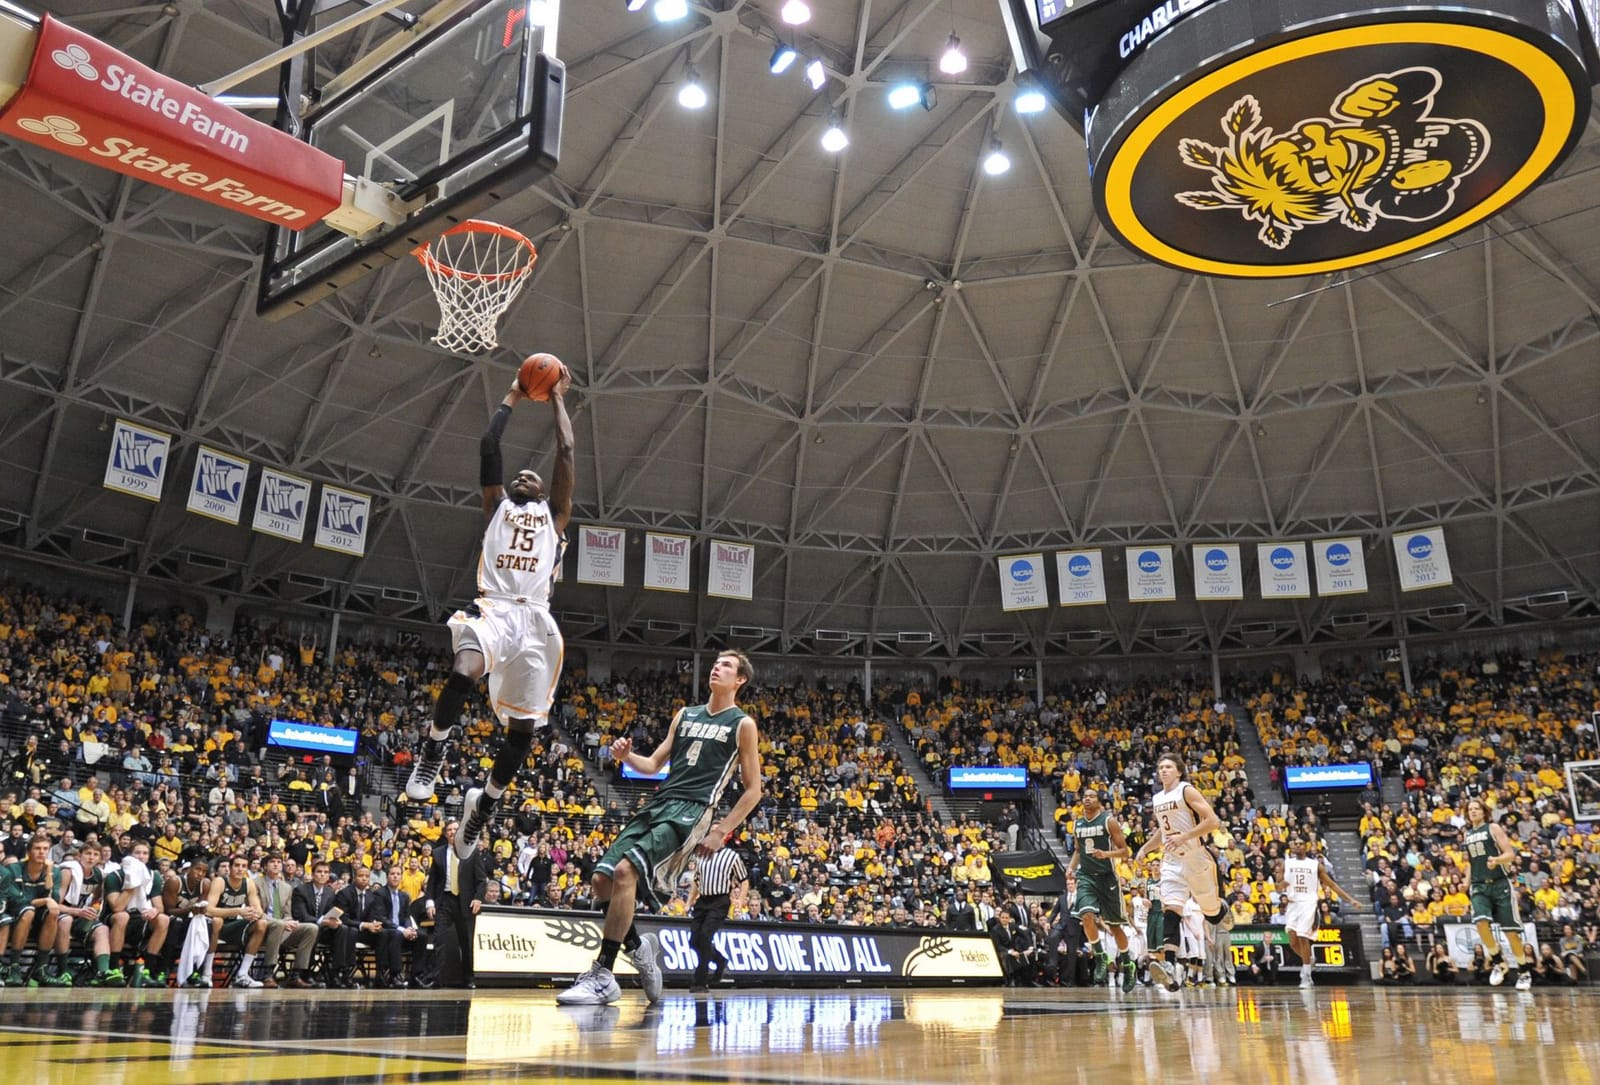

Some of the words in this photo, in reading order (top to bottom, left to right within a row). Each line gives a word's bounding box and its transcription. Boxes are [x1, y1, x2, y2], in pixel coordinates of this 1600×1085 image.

[1119, 0, 1208, 58] CHARLE
[1402, 125, 1450, 165] WSU
[121, 475, 148, 489] 1999
[204, 500, 226, 513] 2000
[268, 519, 290, 532] 2011
[330, 534, 353, 547] 2012
[509, 527, 535, 552] 15
[585, 529, 621, 550] VALLEY
[652, 536, 687, 556] VALLEY
[717, 543, 750, 565] VALLEY
[1410, 544, 1433, 555] NCAA
[496, 554, 538, 573] STATE
[1140, 560, 1162, 568] NCAA
[1208, 559, 1229, 567] NCAA
[1273, 557, 1295, 565] NCAA
[1328, 553, 1352, 561] NCAA
[1013, 569, 1034, 577] NCAA
[1071, 564, 1092, 572] NCAA
[657, 575, 677, 585] 2007
[1332, 579, 1353, 589] 2011
[1415, 571, 1437, 583] 2012
[1275, 583, 1297, 592] 2010
[1073, 590, 1093, 600] 2007
[397, 631, 421, 648] 122
[680, 720, 732, 743] TRIBE
[686, 740, 703, 766] 4
[1162, 814, 1171, 831] 3
[1075, 824, 1105, 838] TRIBE
[1295, 874, 1305, 885] 12
[1317, 928, 1342, 942] RIBE
[477, 933, 537, 957] Fidelity
[659, 928, 769, 971] SHKERS
[768, 933, 811, 972] ONE
[811, 935, 851, 972] AND
[852, 937, 892, 973] ALL.
[1324, 945, 1343, 965] 16
